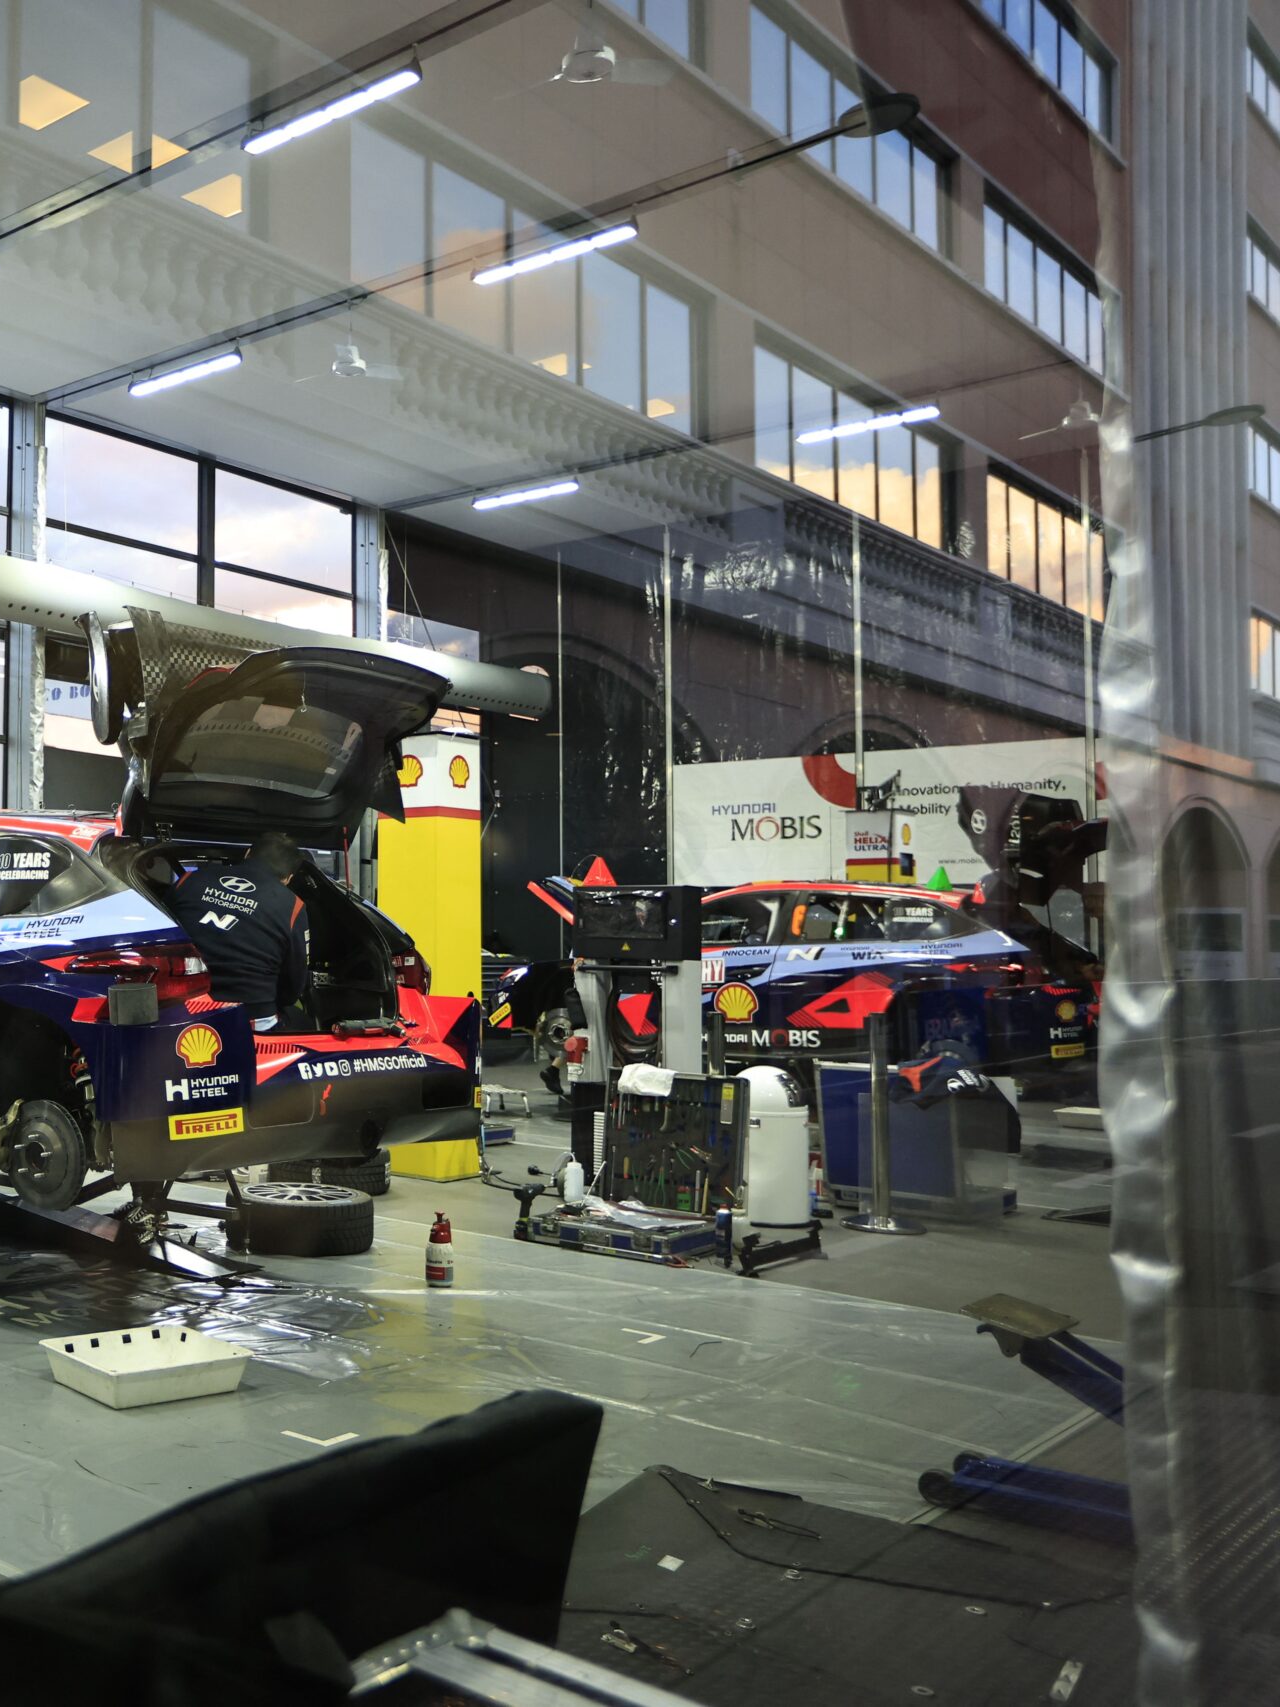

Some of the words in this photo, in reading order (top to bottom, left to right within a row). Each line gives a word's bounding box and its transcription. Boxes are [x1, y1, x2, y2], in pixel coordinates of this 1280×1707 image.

[712, 802, 776, 816] HYUNDAI
[731, 815, 822, 842] MOBIS
[854, 844, 888, 852] ULTRA
[13, 852, 51, 868] YEARS
[201, 894, 255, 916] MOTORSPORT
[205, 886, 258, 910] HYUNDAI
[905, 906, 934, 917] YEARS
[27, 916, 84, 929] HYUNDAI
[24, 928, 62, 939] STEEL
[722, 948, 771, 957] INNOCEAN
[751, 1029, 822, 1048] MOBIS
[353, 1054, 427, 1072] #HMSGOfficial
[191, 1074, 239, 1088] HYUNDAI
[191, 1087, 228, 1099] STEEL
[175, 1113, 237, 1135] PIRELLI
